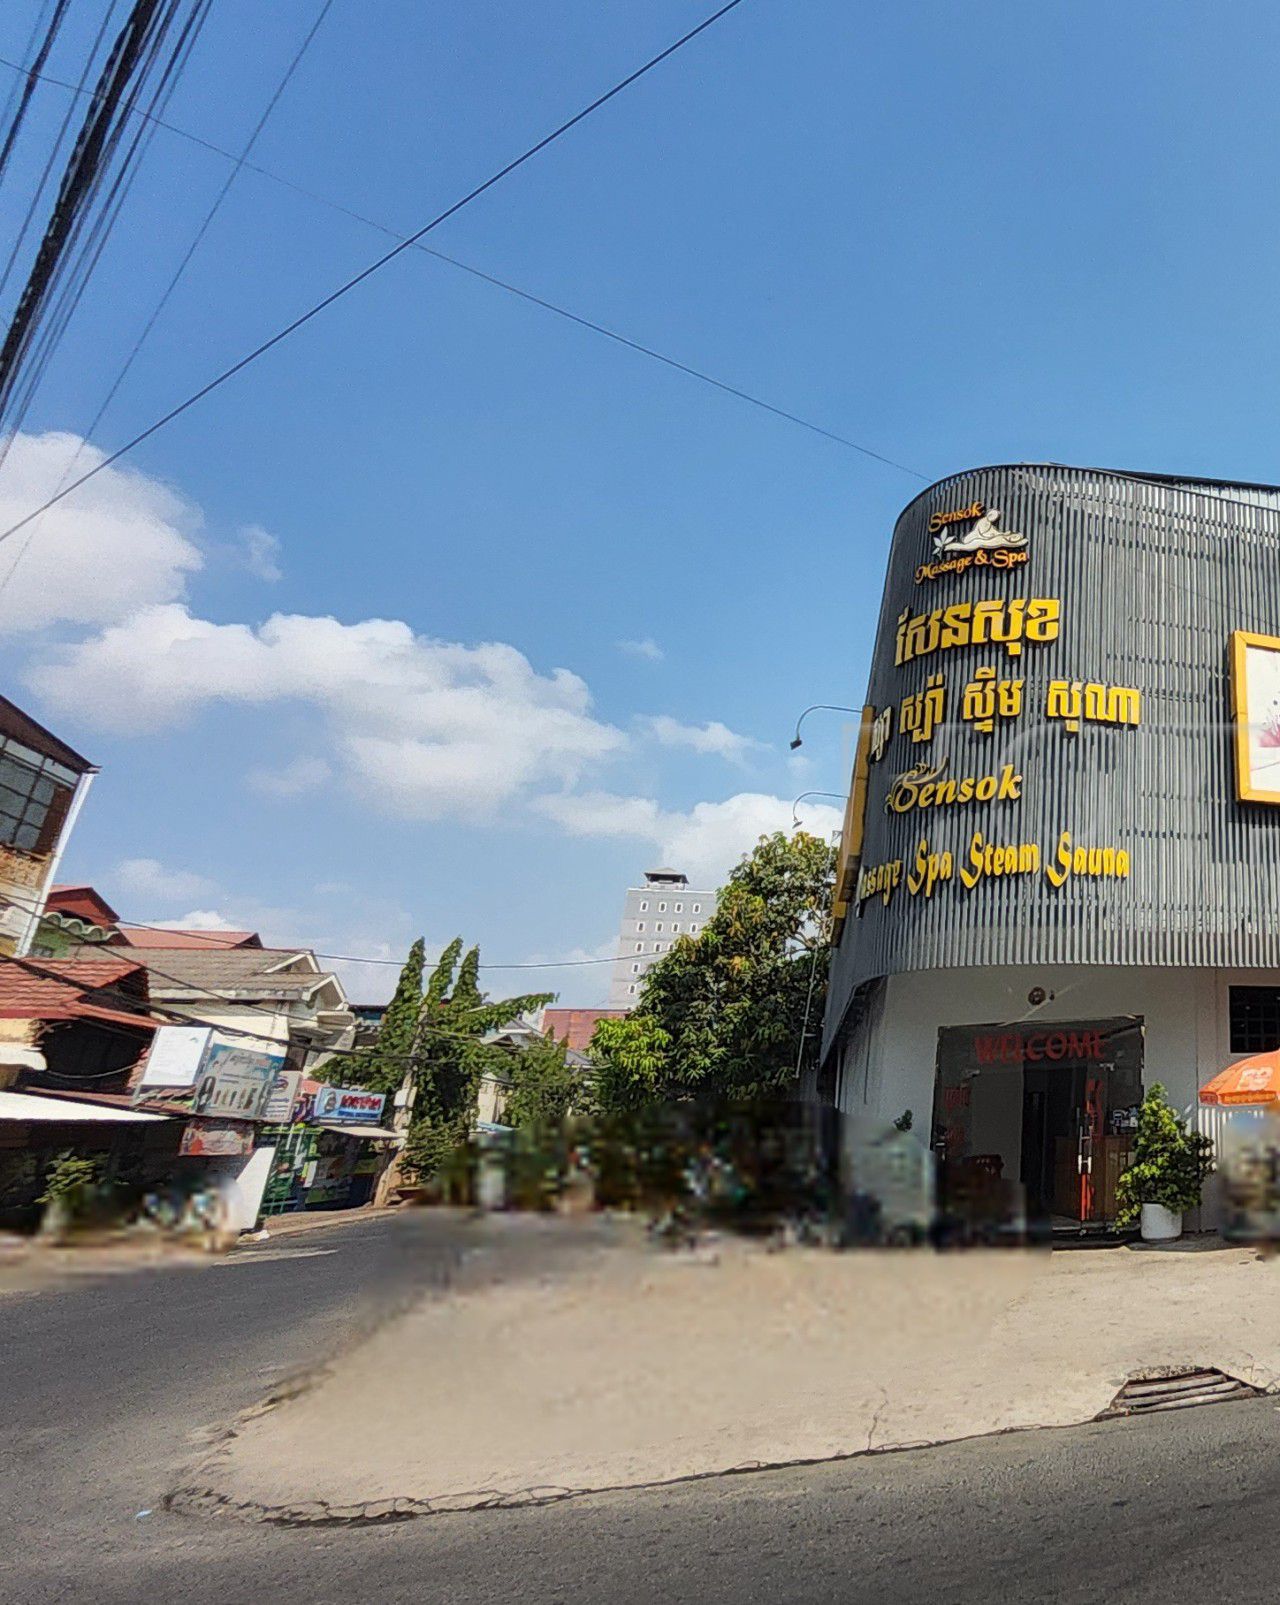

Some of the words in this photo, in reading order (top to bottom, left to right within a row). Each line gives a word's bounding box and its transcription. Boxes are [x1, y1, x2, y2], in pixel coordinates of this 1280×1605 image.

[927, 501, 983, 534] Sensok
[915, 556, 973, 584] Massage
[974, 550, 992, 566] &
[992, 550, 1028, 570] Spa
[884, 757, 1023, 814] Sensok
[856, 858, 903, 917] assage
[907, 838, 952, 898] Spa
[960, 831, 1040, 889] Steam
[1047, 831, 1130, 888] Sauna
[974, 1030, 1107, 1065] WELCOME
